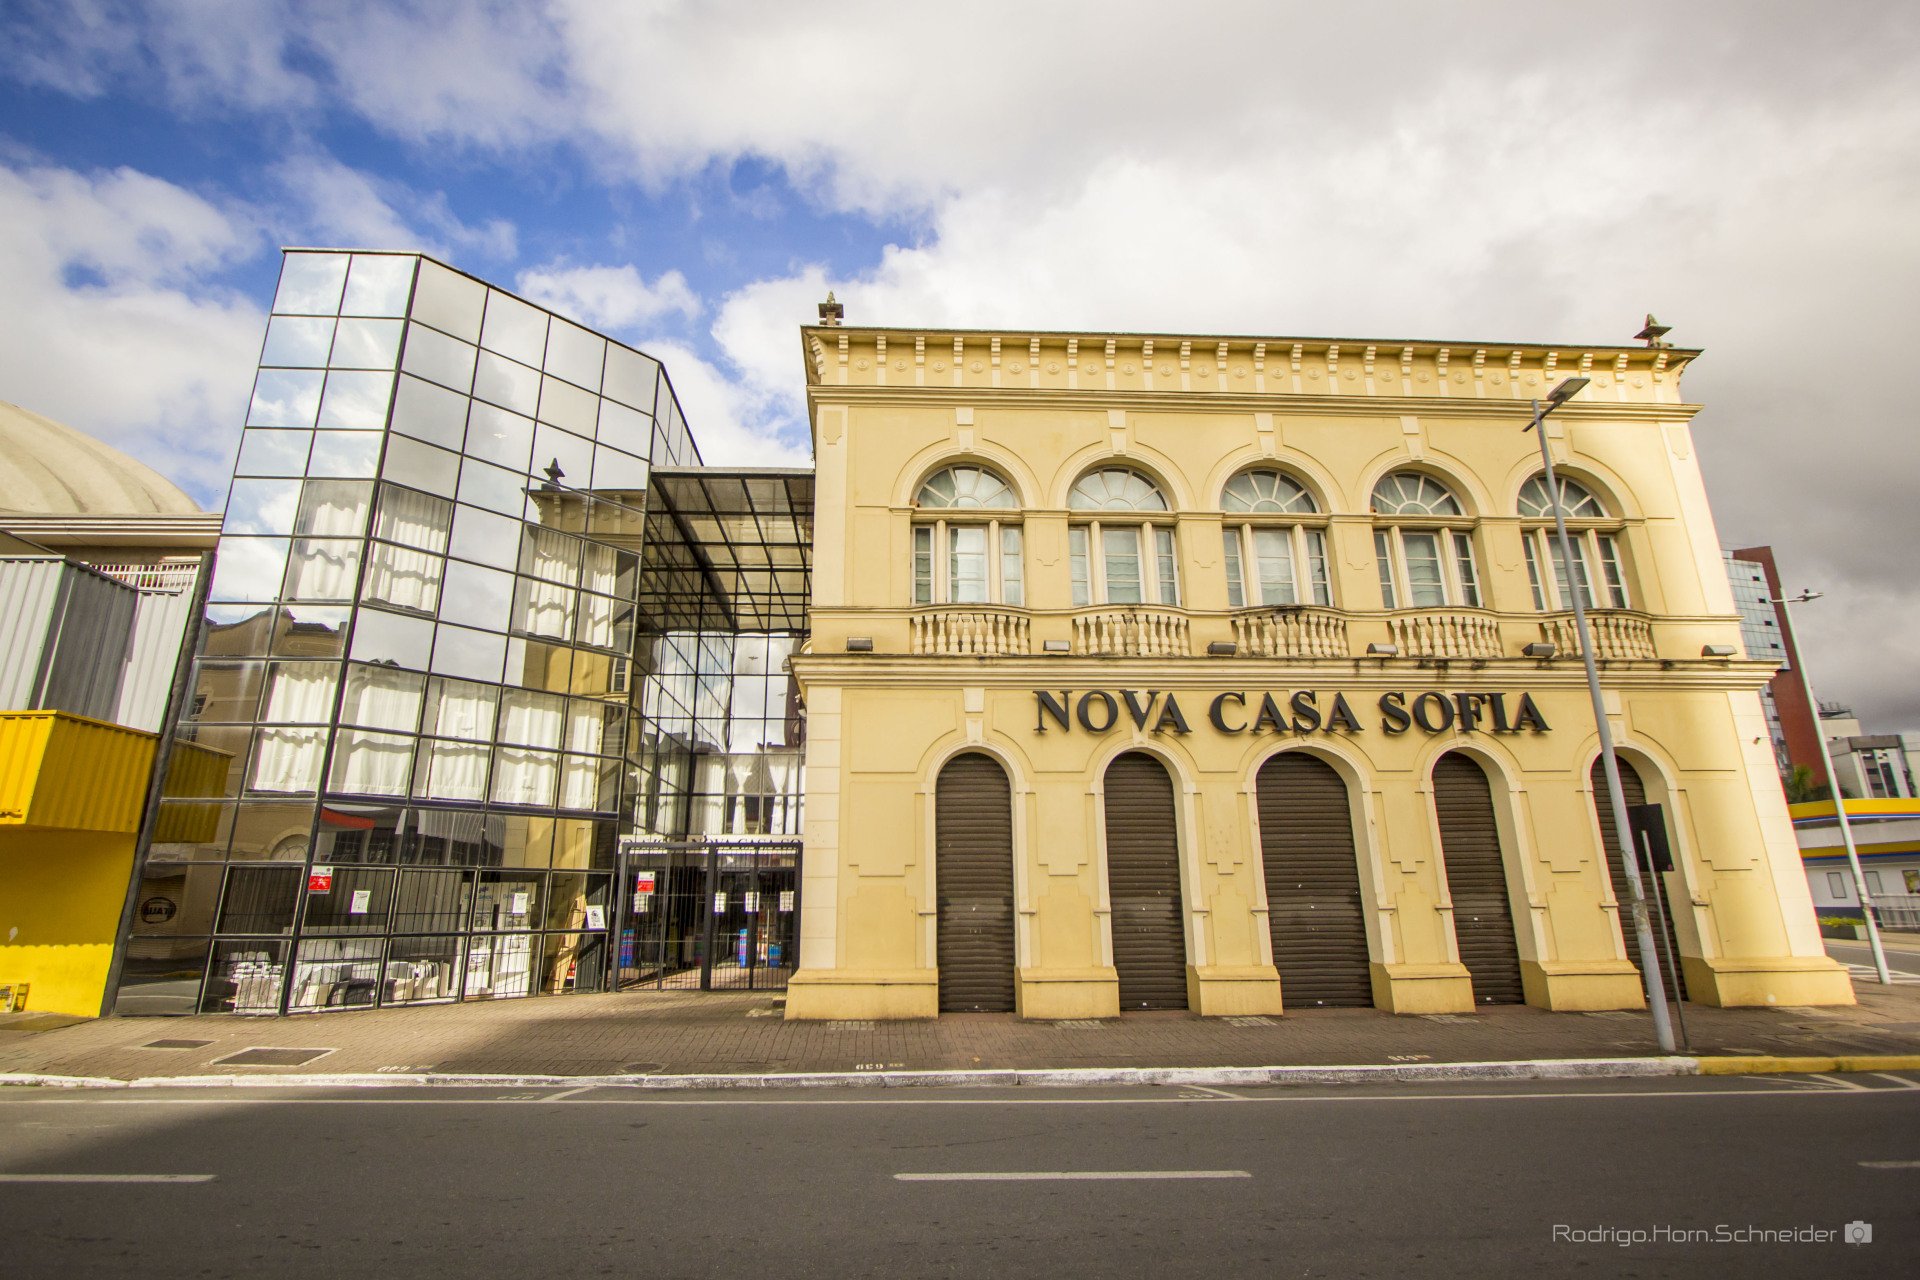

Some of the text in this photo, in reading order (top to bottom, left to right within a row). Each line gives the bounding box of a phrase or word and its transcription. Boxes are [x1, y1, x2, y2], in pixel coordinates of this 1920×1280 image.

[1032, 689, 1552, 733] NOVA CASA SOFIA
